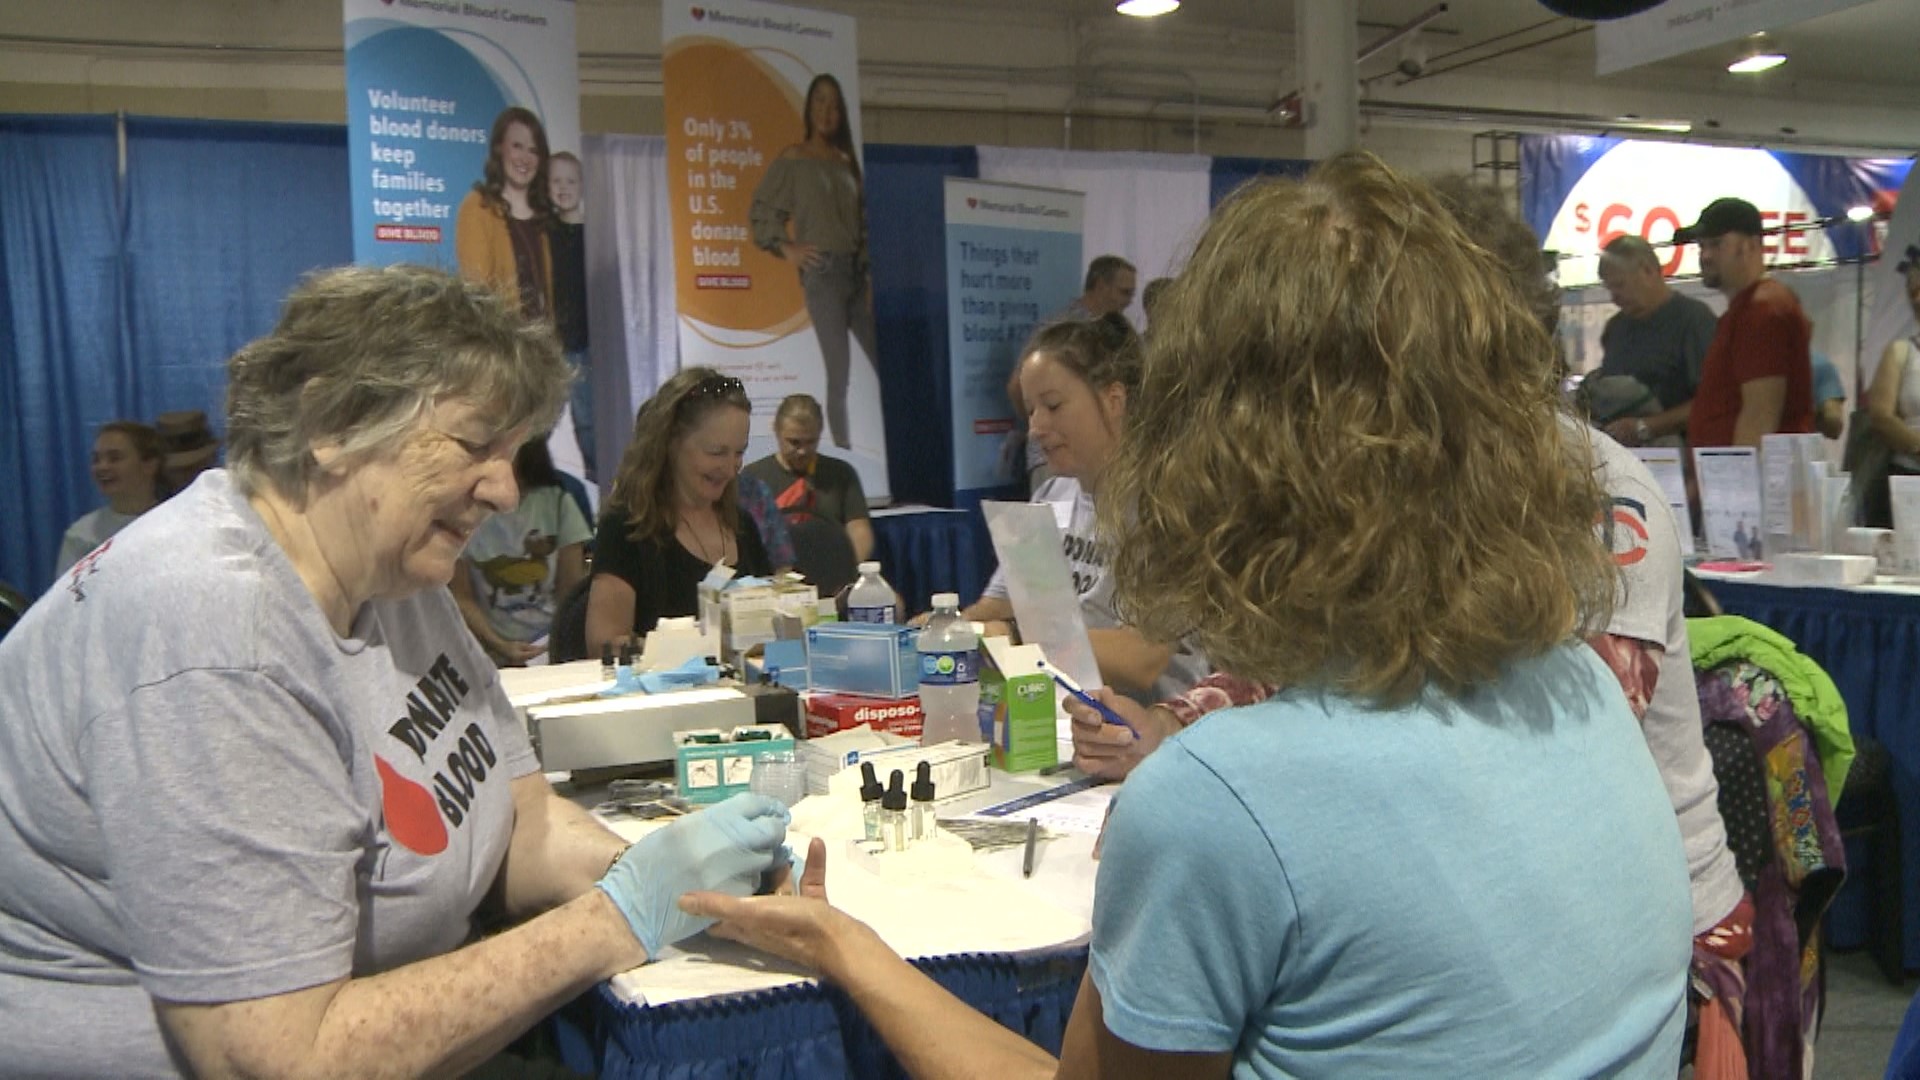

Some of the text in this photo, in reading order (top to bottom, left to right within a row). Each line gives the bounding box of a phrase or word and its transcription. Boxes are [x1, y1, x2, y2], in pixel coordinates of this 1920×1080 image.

[368, 88, 456, 115] Volunteer
[370, 114, 487, 144] blood donors
[683, 117, 752, 142] Only 3%
[371, 141, 416, 168] keep
[685, 144, 763, 167] of people
[372, 168, 445, 192] families
[688, 170, 737, 189] in the
[373, 197, 451, 222] together
[689, 195, 723, 214] U.S.
[691, 222, 748, 241] donate
[694, 246, 740, 266] blood
[960, 241, 1039, 268] Things that
[961, 269, 1031, 290] hurt more
[962, 297, 1038, 321] than giving
[963, 322, 1004, 342] blood
[434, 723, 496, 828] BLOOD
